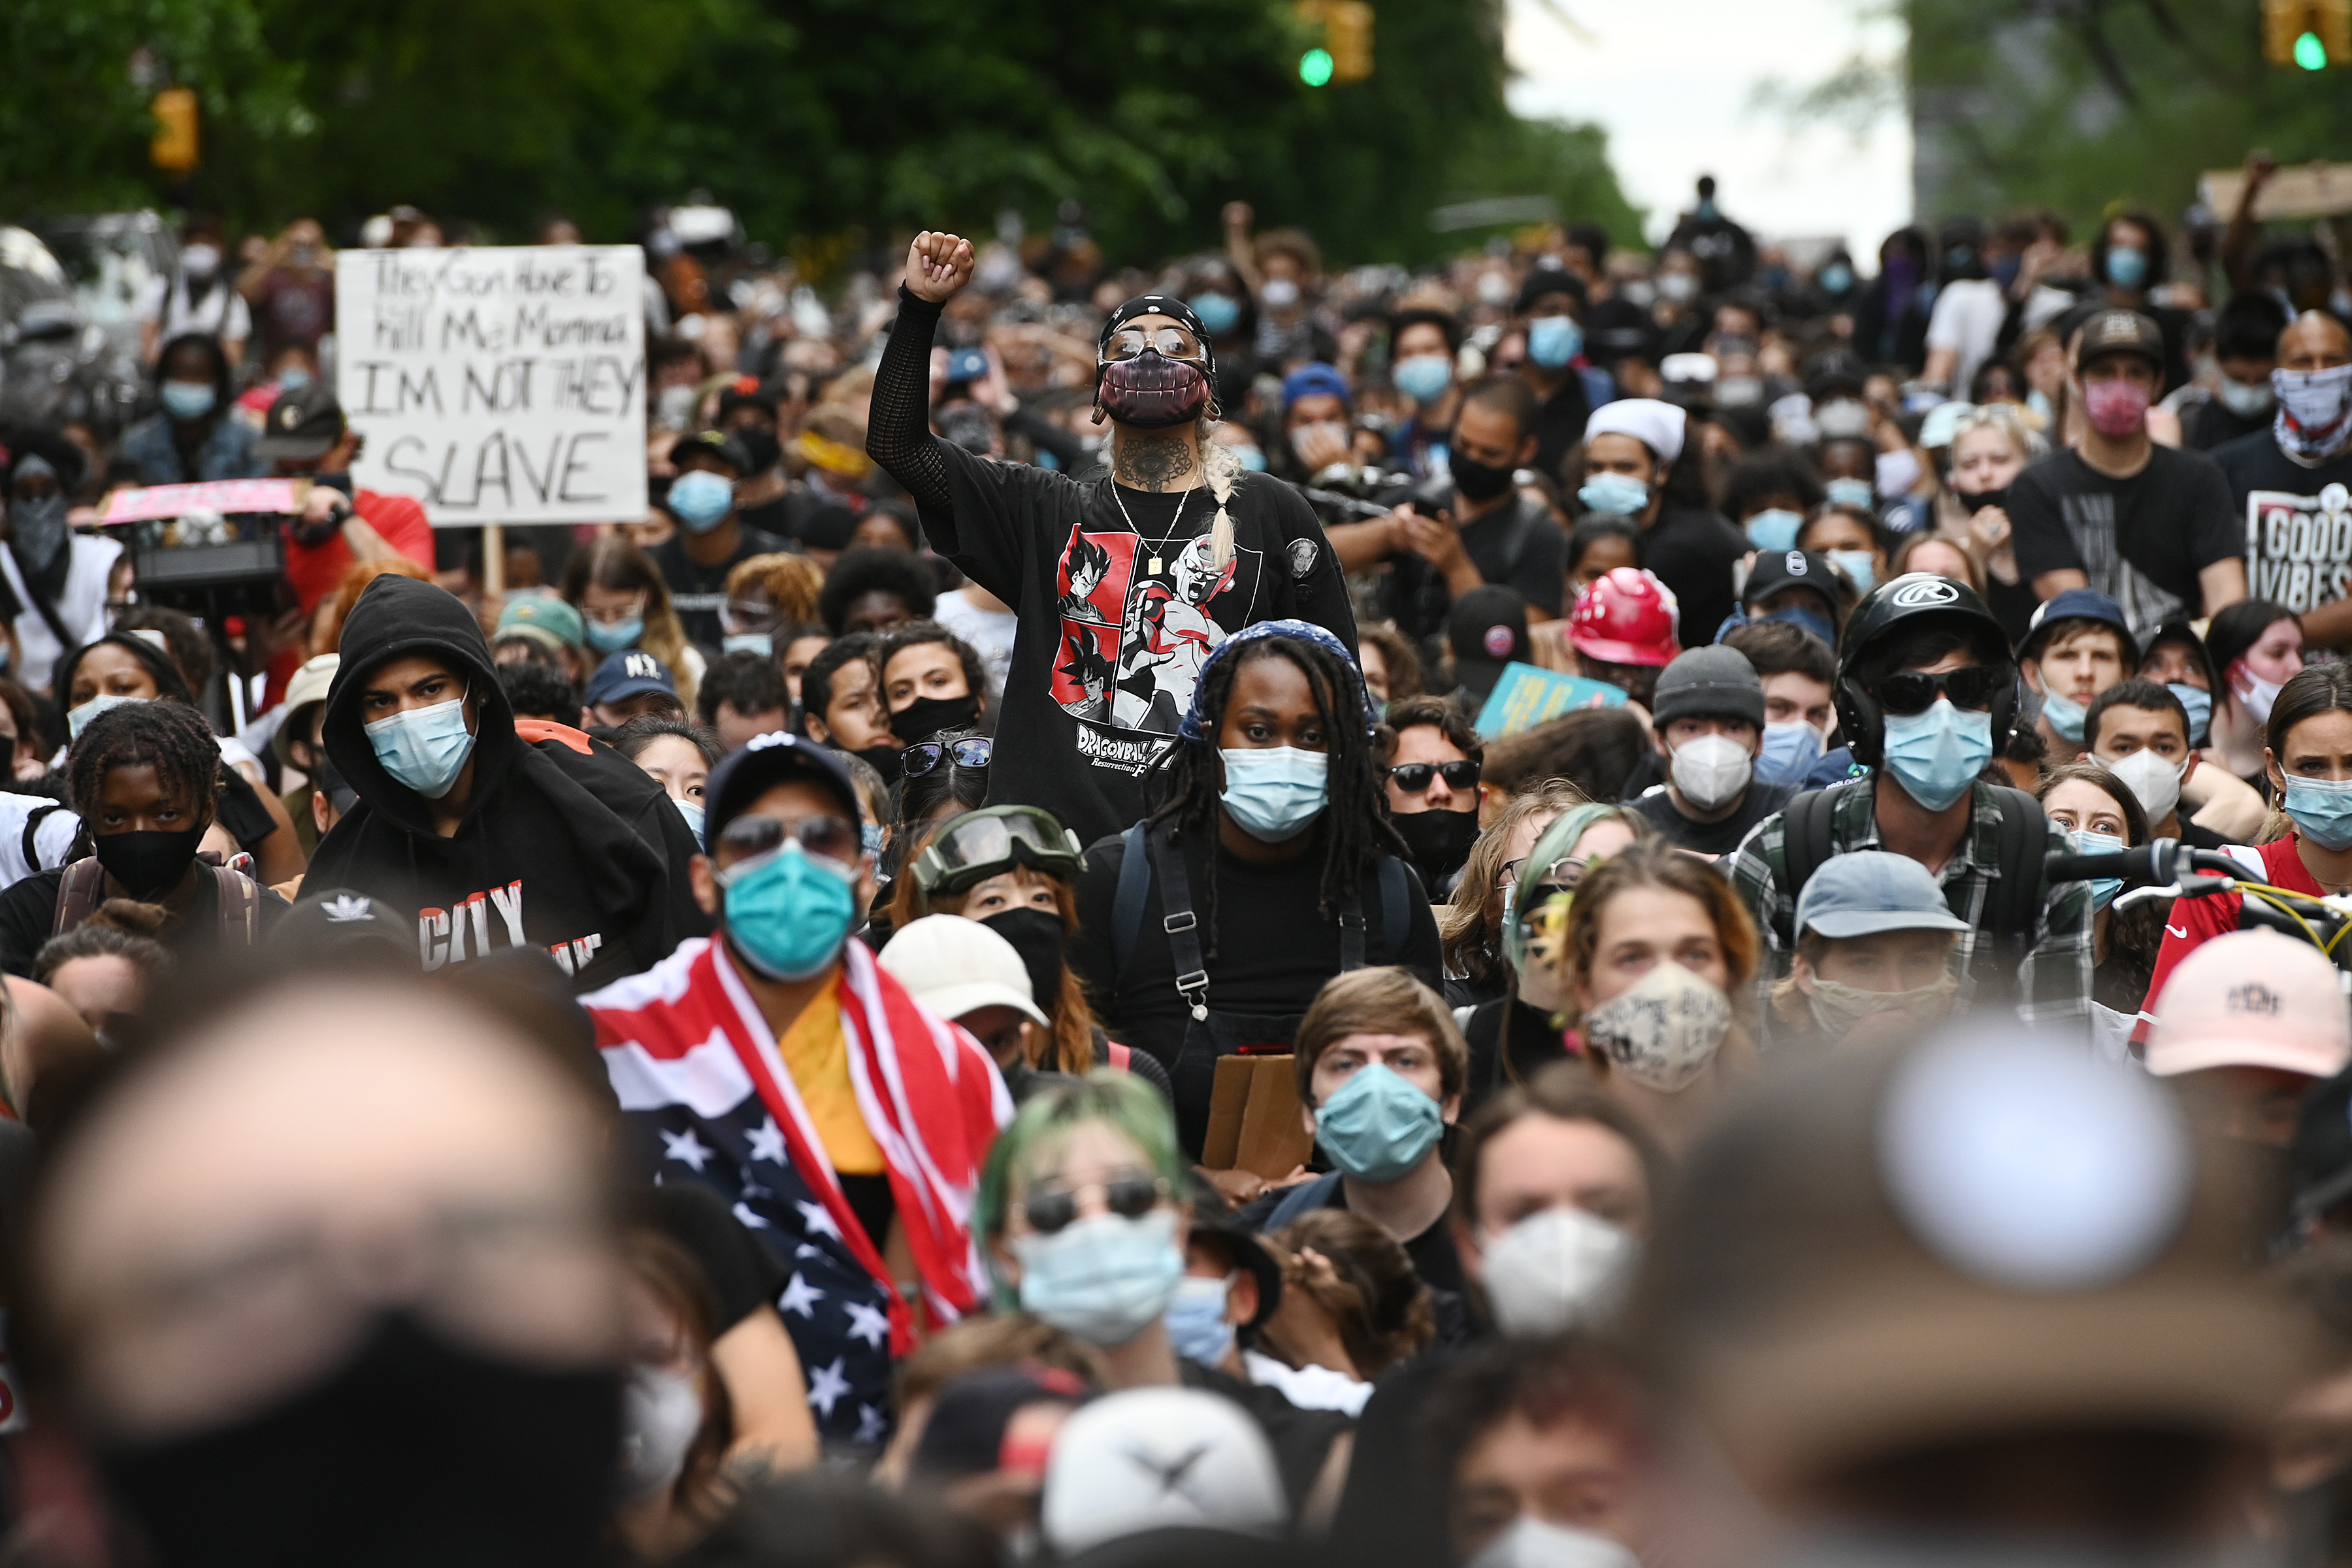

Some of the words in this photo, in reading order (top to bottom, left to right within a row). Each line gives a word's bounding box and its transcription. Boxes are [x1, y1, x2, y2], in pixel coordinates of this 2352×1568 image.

[367, 250, 461, 308] They
[515, 256, 580, 297] Have
[579, 252, 617, 296] To
[353, 361, 444, 419] IM
[462, 356, 540, 417] NOT
[550, 355, 647, 419] THEY
[384, 429, 613, 507] SLAVE
[2265, 506, 2352, 563] GOOD
[1899, 583, 1950, 604] R
[1091, 758, 1135, 773] Resurrection
[419, 879, 526, 972] CITY
